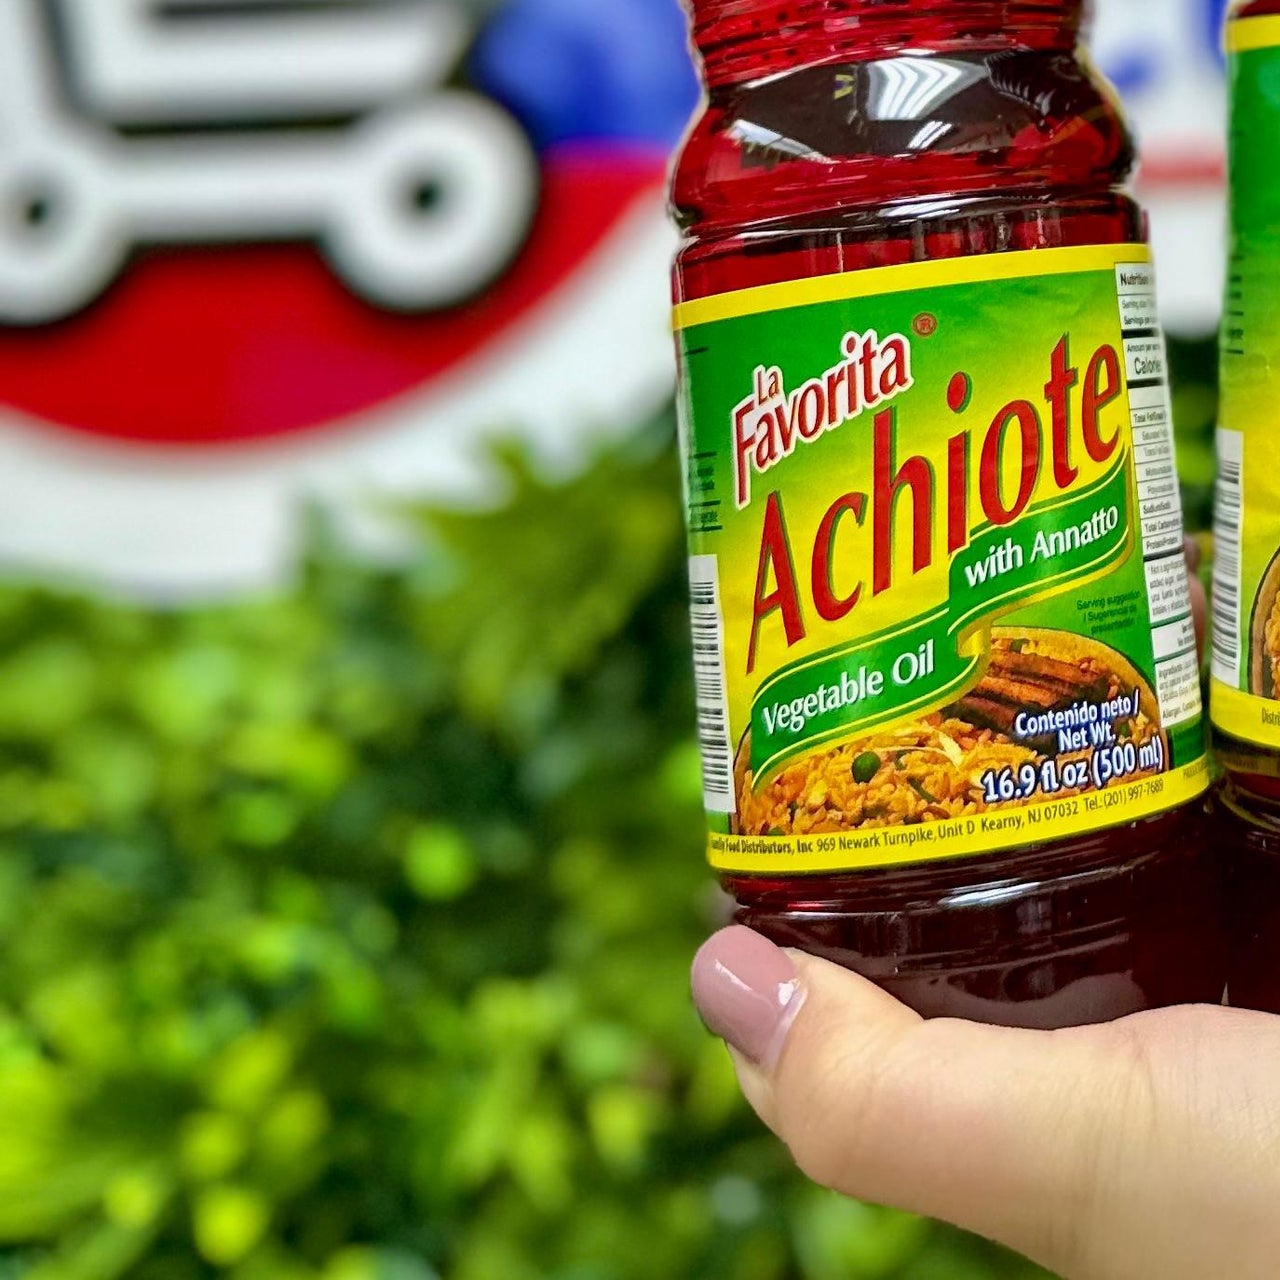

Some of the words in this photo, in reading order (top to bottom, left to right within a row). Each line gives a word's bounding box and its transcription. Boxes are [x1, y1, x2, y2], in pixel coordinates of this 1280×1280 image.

[733, 333, 910, 506] Favorita
[755, 369, 780, 406] La
[745, 331, 1122, 676] Achiote
[965, 539, 1023, 588] with
[1030, 505, 1119, 563] Annatto
[763, 666, 884, 735] Vegetable
[892, 638, 935, 685] Oil
[1015, 701, 1098, 736] Contenido
[983, 763, 1036, 803] 16.9
[1040, 760, 1060, 792] fl
[1062, 761, 1089, 787] oz
[1092, 742, 1136, 788] (500
[1139, 735, 1164, 771] ml)
[1058, 730, 1088, 752] Net
[1090, 723, 1116, 746] Wt.
[741, 837, 795, 856] Distributors,
[797, 838, 813, 853] Inc
[817, 836, 836, 852] 969
[839, 833, 881, 850] Newark
[884, 827, 937, 849] Turnpike,
[937, 819, 963, 839] Unit
[966, 820, 975, 835] D
[981, 813, 1025, 833] Kearny,
[1027, 808, 1042, 825] NJ
[1043, 803, 1080, 821] 07032
[1103, 788, 1127, 809] (201)
